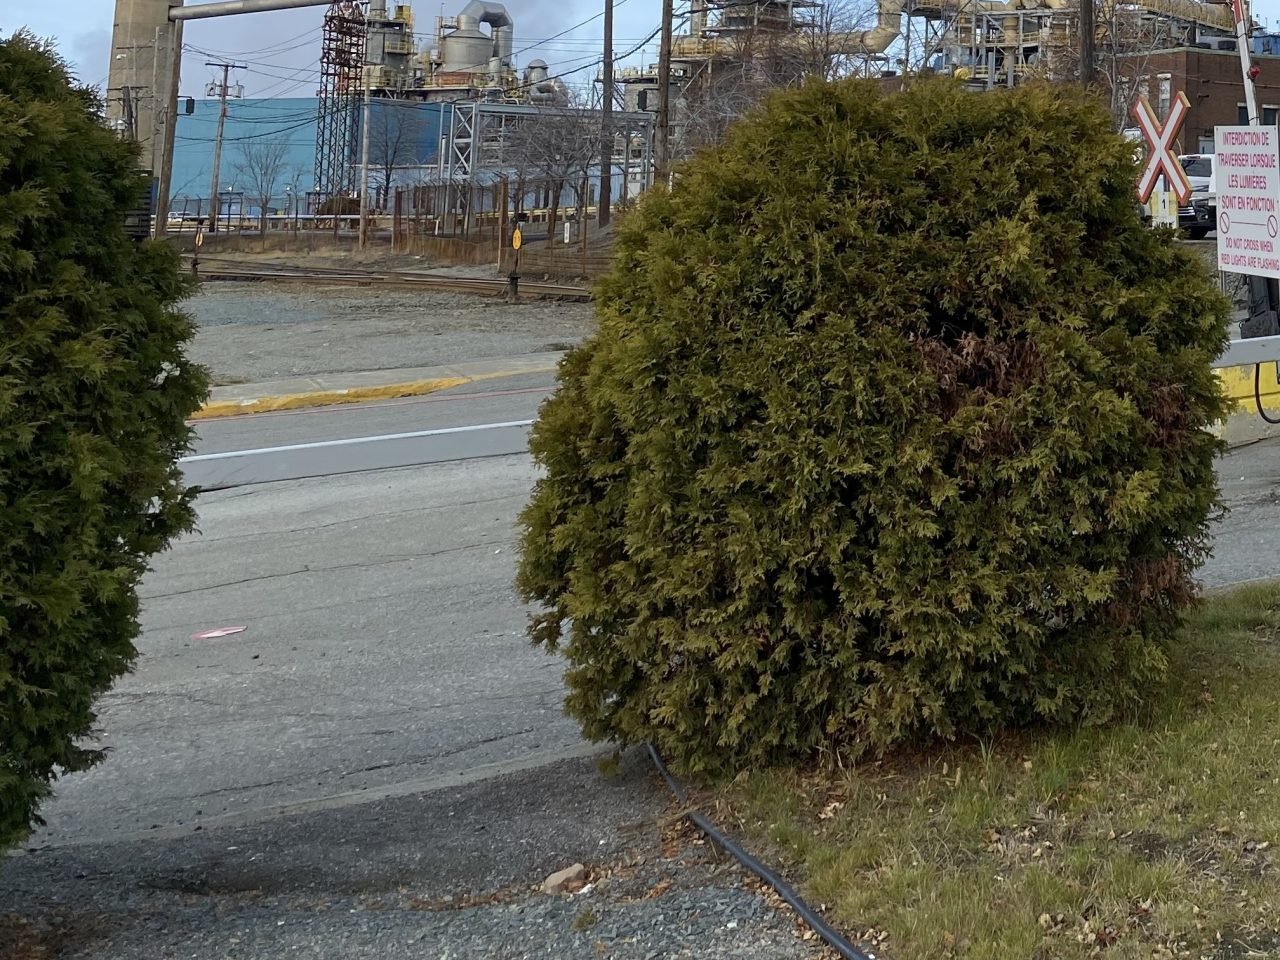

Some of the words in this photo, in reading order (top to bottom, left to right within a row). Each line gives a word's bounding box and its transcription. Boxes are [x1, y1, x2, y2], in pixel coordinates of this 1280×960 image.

[1223, 131, 1260, 146] INTERDICTION
[1261, 131, 1270, 146] DE
[1218, 153, 1249, 167] TRAVERSER
[1250, 154, 1276, 168] LORSQUE
[1228, 174, 1239, 188] LES
[1162, 198, 1166, 209] 1
[1221, 195, 1236, 209] SONT
[1237, 196, 1245, 210] EN
[1246, 196, 1275, 212] FONCTION
[1225, 237, 1233, 248] DO
[1233, 238, 1242, 249] NOT
[1244, 239, 1259, 251] CROSS
[1260, 241, 1274, 252] WHEN
[1221, 253, 1230, 265] RED
[1231, 254, 1246, 266] LIGHTS
[1247, 256, 1256, 268] ARE
[1258, 258, 1280, 271] FLASHING
